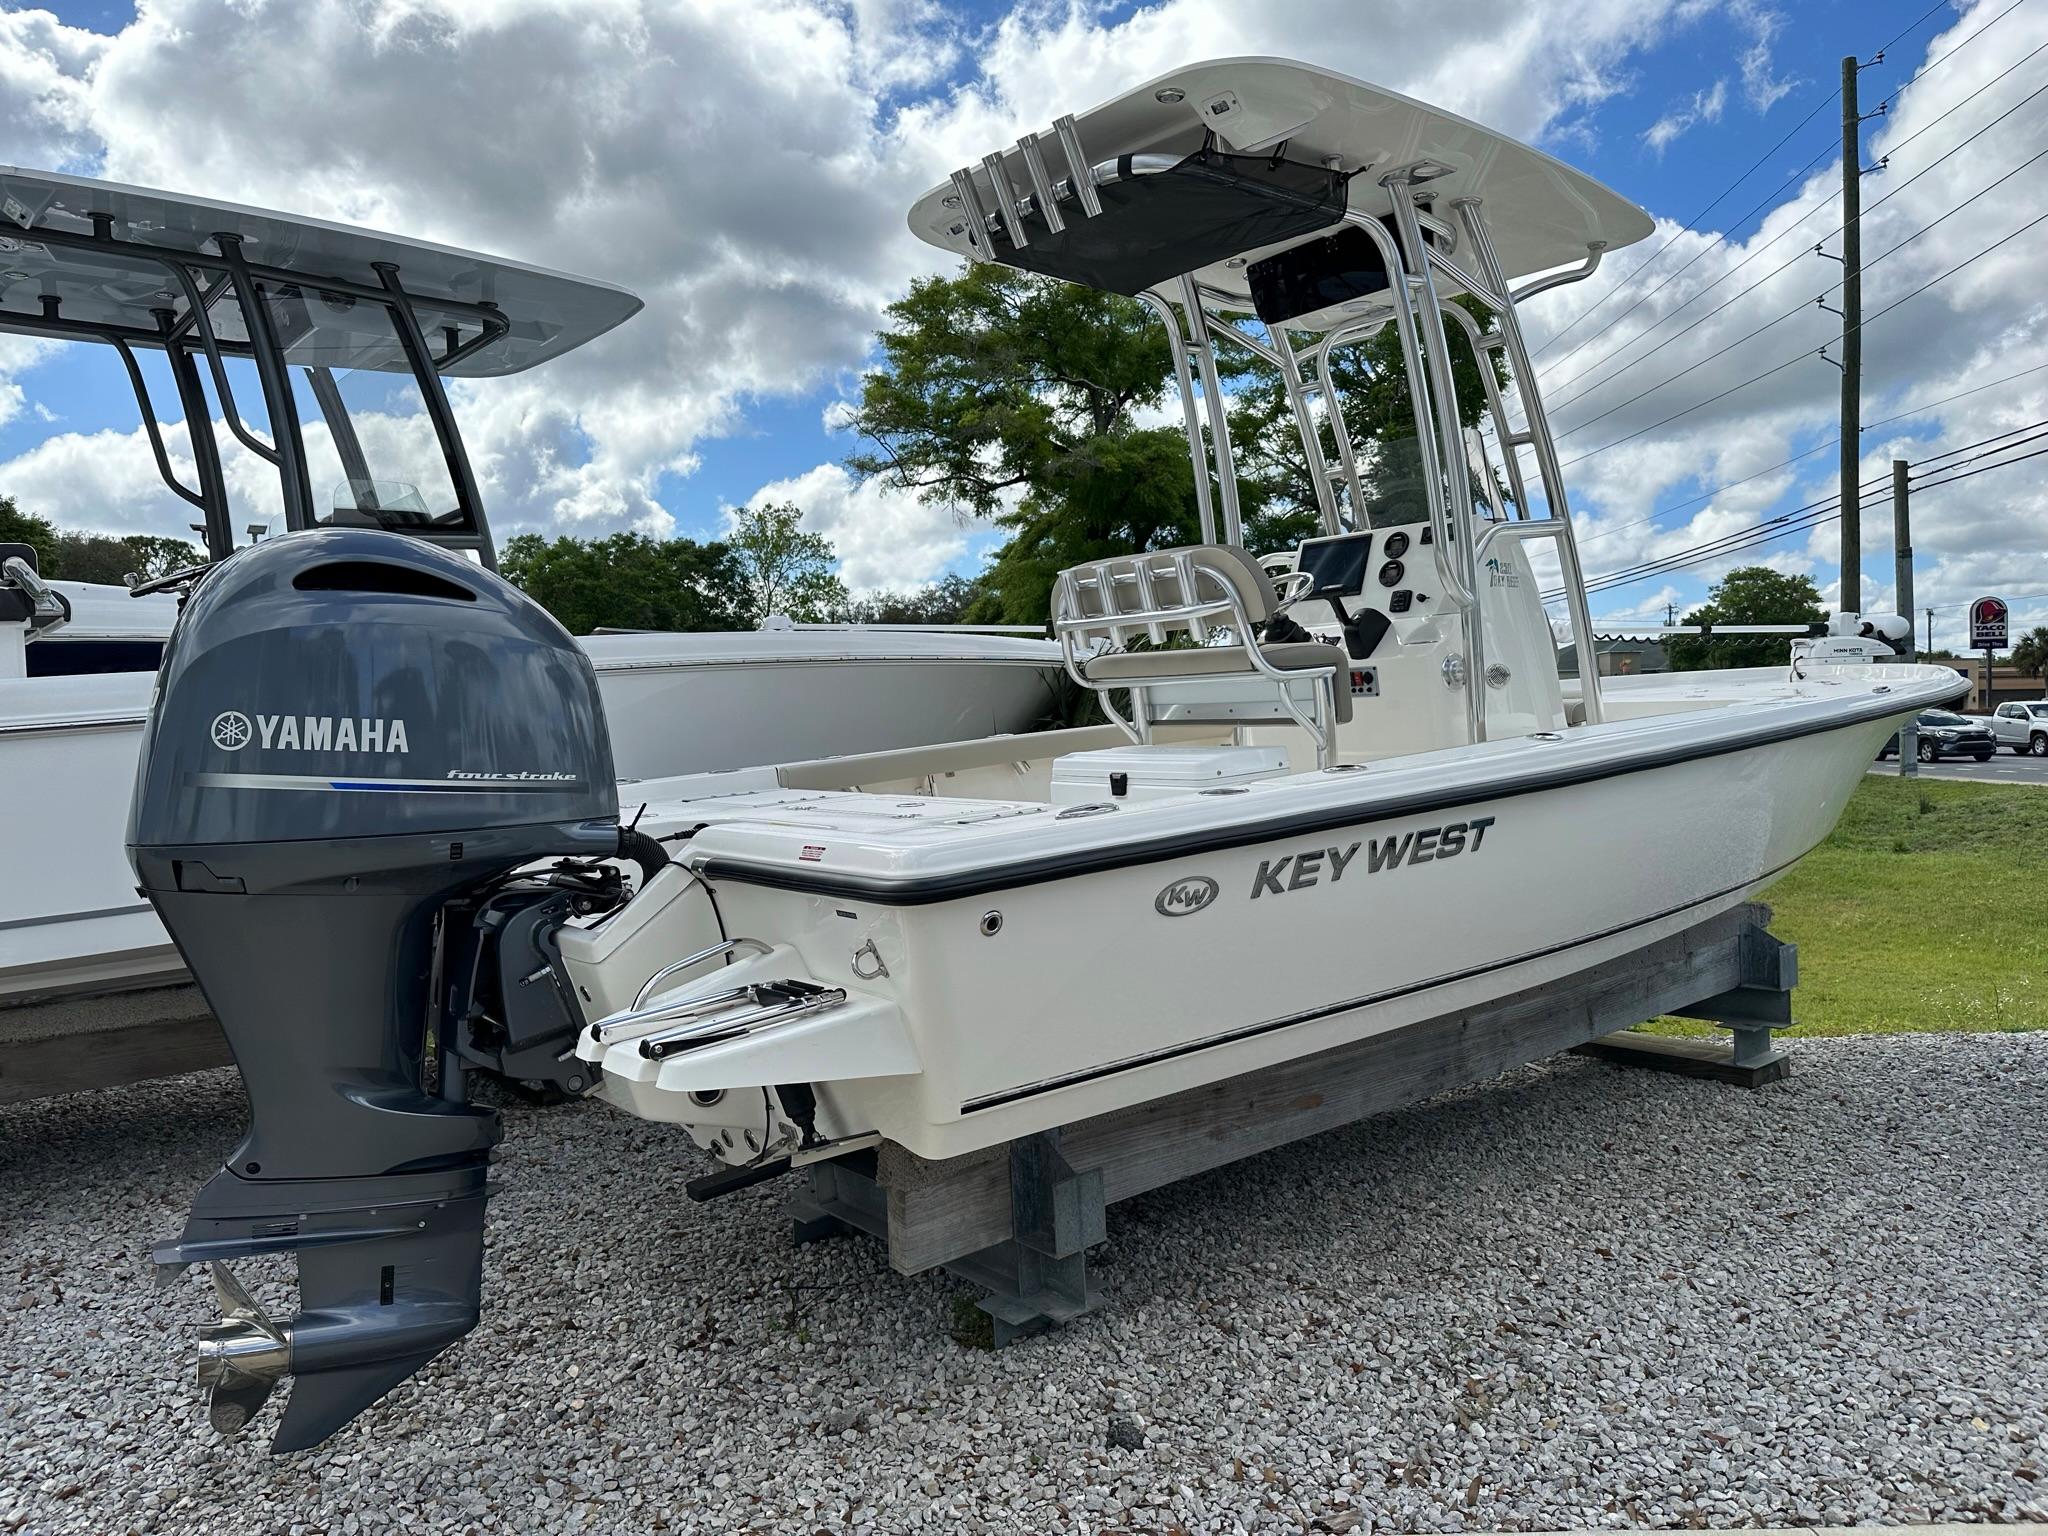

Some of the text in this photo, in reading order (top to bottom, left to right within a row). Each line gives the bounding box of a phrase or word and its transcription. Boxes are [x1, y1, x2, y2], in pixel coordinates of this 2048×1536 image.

[255, 714, 409, 753] YAMAHA
[1250, 816, 1495, 899] KEY WEST
[1167, 885, 1209, 907] KW
